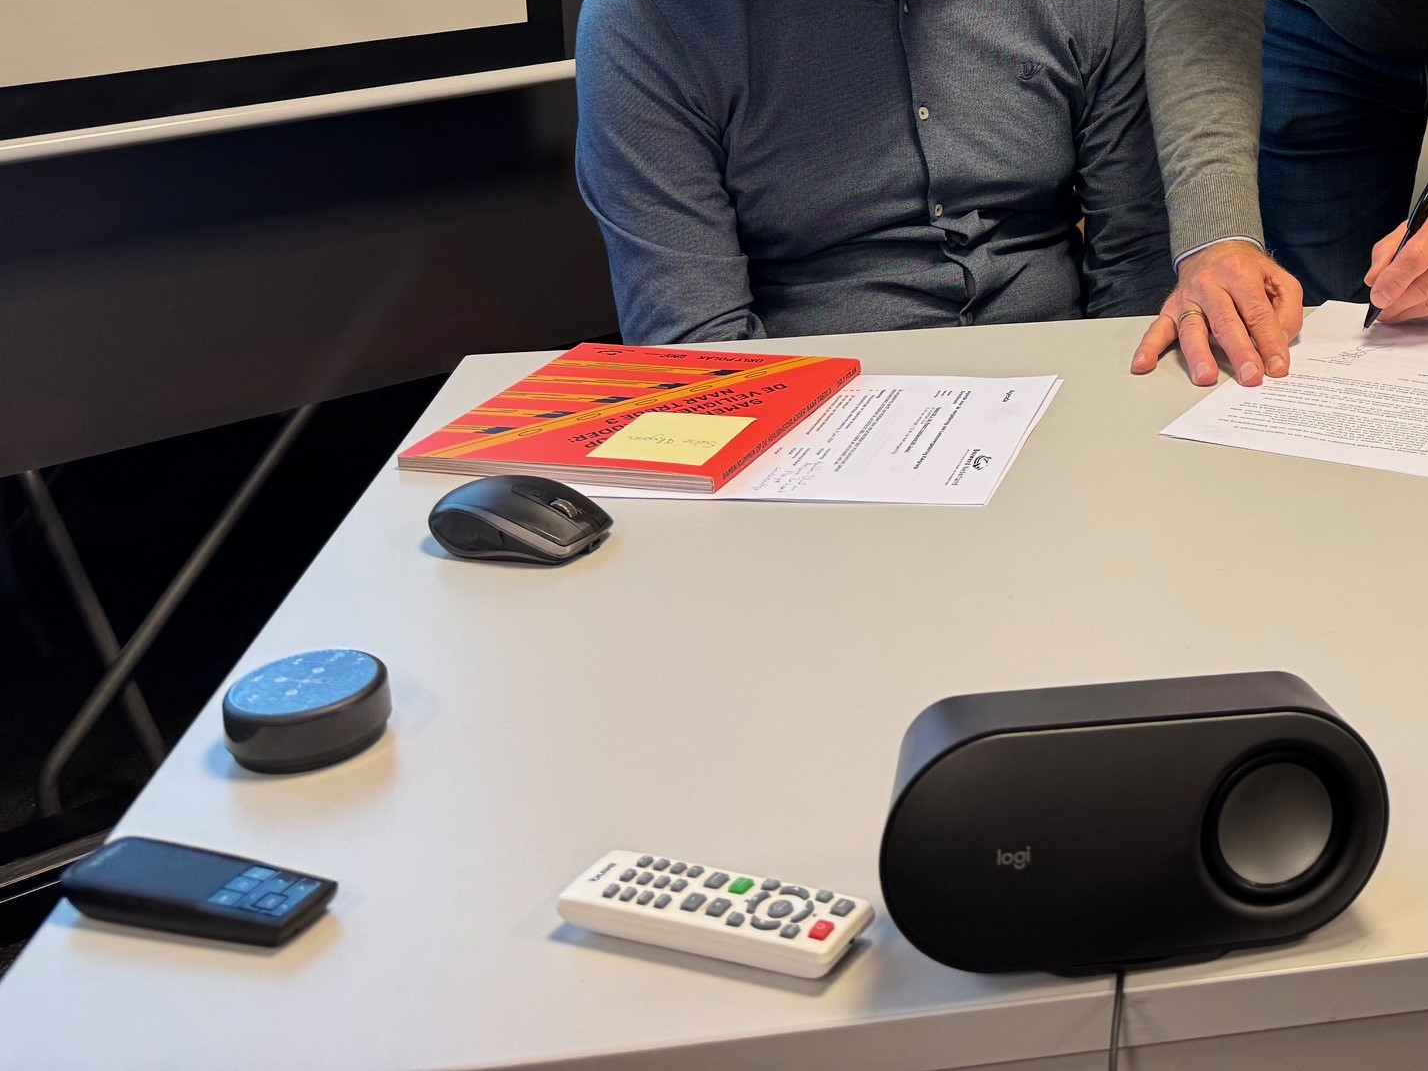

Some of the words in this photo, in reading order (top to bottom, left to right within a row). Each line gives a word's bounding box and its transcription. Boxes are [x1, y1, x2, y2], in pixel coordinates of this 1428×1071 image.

[682, 388, 736, 405] NAAR
[761, 383, 788, 393] DE
[997, 846, 1031, 870] logi
